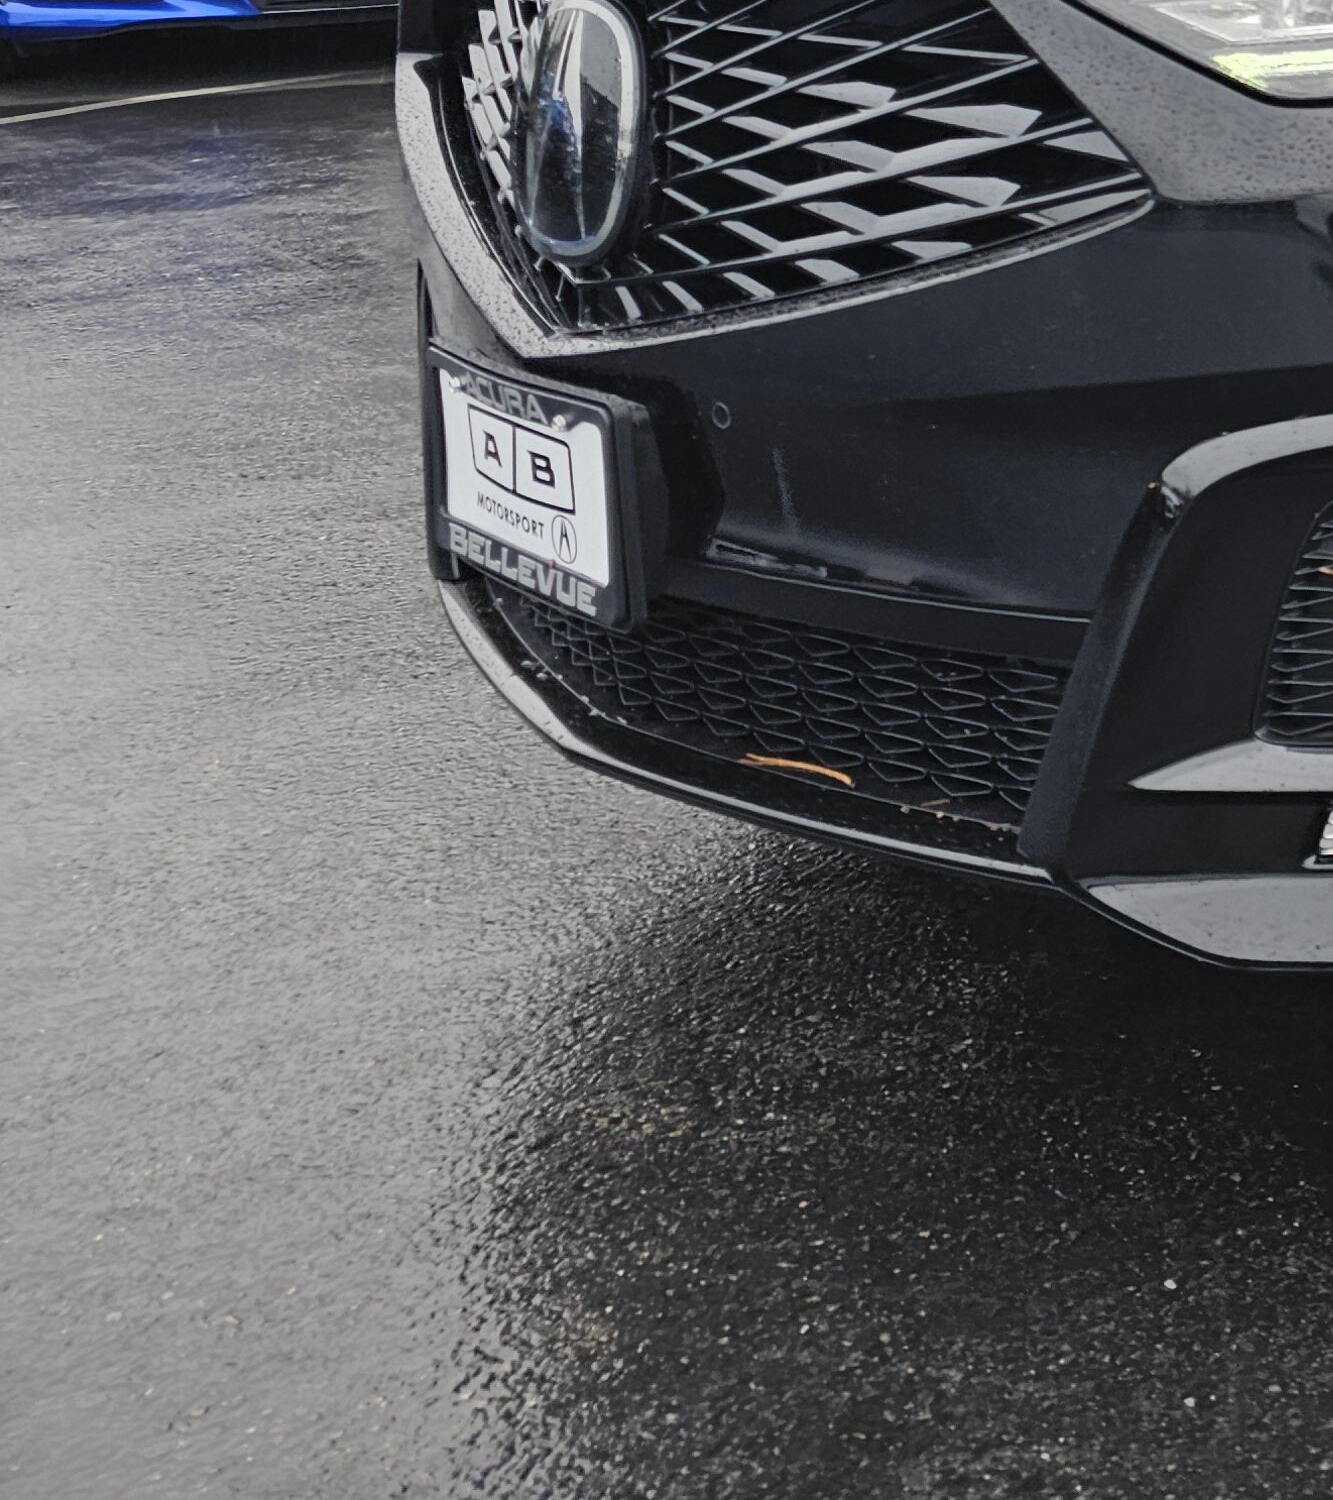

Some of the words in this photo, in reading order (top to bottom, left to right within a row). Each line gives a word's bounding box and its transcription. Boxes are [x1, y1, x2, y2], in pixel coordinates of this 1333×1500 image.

[466, 374, 548, 425] ACURA
[483, 430, 503, 468] A
[527, 450, 556, 489] B
[477, 491, 545, 539] MOTORSPORT
[449, 523, 597, 617] BELLEVUE
